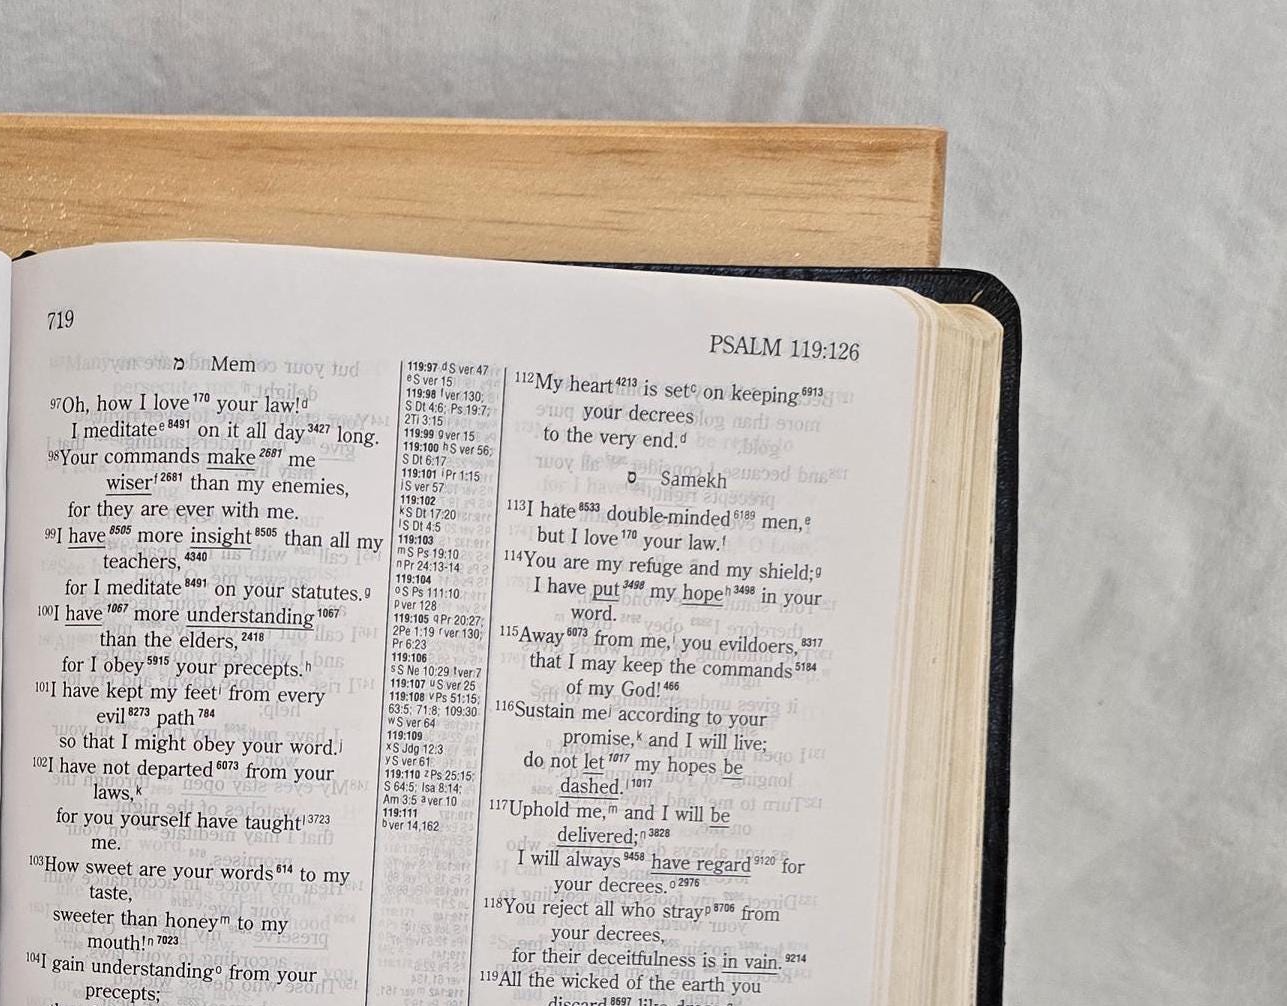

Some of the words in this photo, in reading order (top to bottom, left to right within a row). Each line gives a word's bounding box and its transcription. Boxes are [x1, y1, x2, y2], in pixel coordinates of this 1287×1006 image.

[47, 309, 75, 331] 719
[709, 334, 783, 357] PSALM
[791, 339, 860, 362] 119:126
[210, 355, 256, 373] Mem
[405, 414, 419, 425] 2Ti
[422, 416, 443, 427] 3:15
[190, 472, 230, 492] than
[236, 479, 265, 496] my
[271, 477, 349, 498] enemies,
[660, 470, 727, 489] Samekh
[67, 500, 92, 518] for
[96, 499, 135, 521] they
[140, 504, 169, 517] are
[175, 504, 215, 518] ever
[221, 500, 260, 519] with
[266, 506, 299, 520] me.
[400, 495, 436, 506] 119:102
[563, 557, 590, 571] are
[595, 559, 624, 575] my
[628, 556, 683, 578] refuge
[689, 559, 720, 577] and
[726, 565, 753, 581] my
[393, 639, 403, 650] Pr
[405, 639, 427, 650] 6:23
[392, 652, 427, 663] 119:106
[529, 650, 562, 670] that
[567, 652, 575, 670] I
[581, 658, 617, 675] may
[622, 654, 663, 677] keep
[669, 657, 697, 675] the
[59, 736, 77, 749] so
[83, 731, 115, 750] that
[121, 732, 129, 750] I
[134, 733, 187, 755] might
[192, 734, 236, 756] obey
[241, 741, 284, 757] your
[383, 808, 417, 818] 119:111
[89, 884, 133, 904] taste,
[52, 909, 115, 925] sweeter
[120, 908, 158, 928] than
[511, 946, 537, 963] for
[541, 947, 582, 965] their
[587, 947, 696, 968] deceitfulness
[701, 951, 717, 969] is
[722, 952, 738, 969] in
[744, 953, 782, 970] vain.
[528, 970, 555, 988] the
[560, 971, 620, 990] wicked
[626, 973, 645, 990] of
[648, 974, 676, 991] the
[681, 975, 725, 993] earth
[731, 981, 761, 997] you
